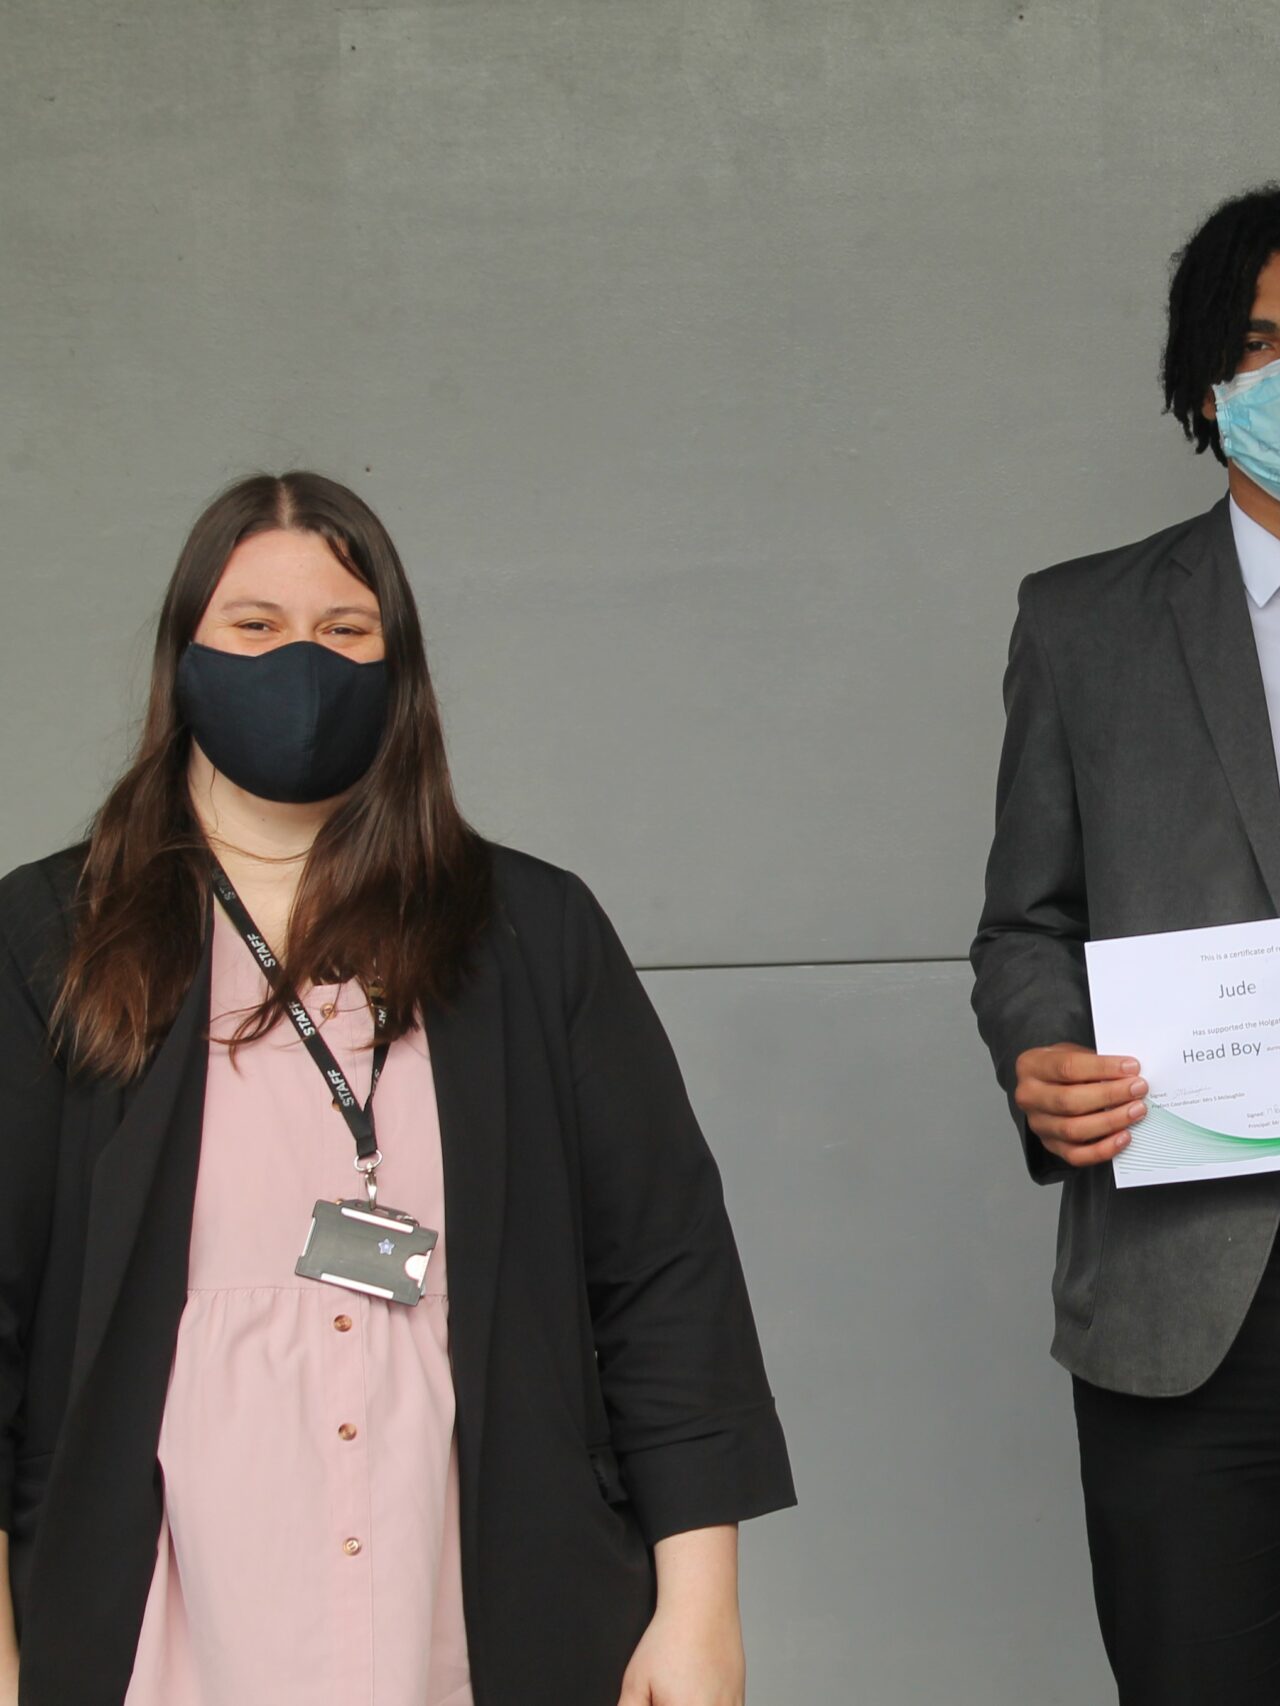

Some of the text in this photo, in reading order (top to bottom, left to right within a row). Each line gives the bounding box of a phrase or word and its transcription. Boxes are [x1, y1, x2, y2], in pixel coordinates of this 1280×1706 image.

[247, 933, 276, 968] STAFF
[1201, 954, 1215, 962] This
[1230, 947, 1265, 959] certificate
[1267, 946, 1274, 954] of
[1218, 980, 1257, 999] Jude
[1192, 1029, 1206, 1037] Has
[1207, 1023, 1244, 1036] supported
[1245, 1021, 1257, 1030] the
[1183, 1046, 1226, 1064] Head
[1231, 1040, 1262, 1056] Boy
[327, 1069, 355, 1107] STAFF
